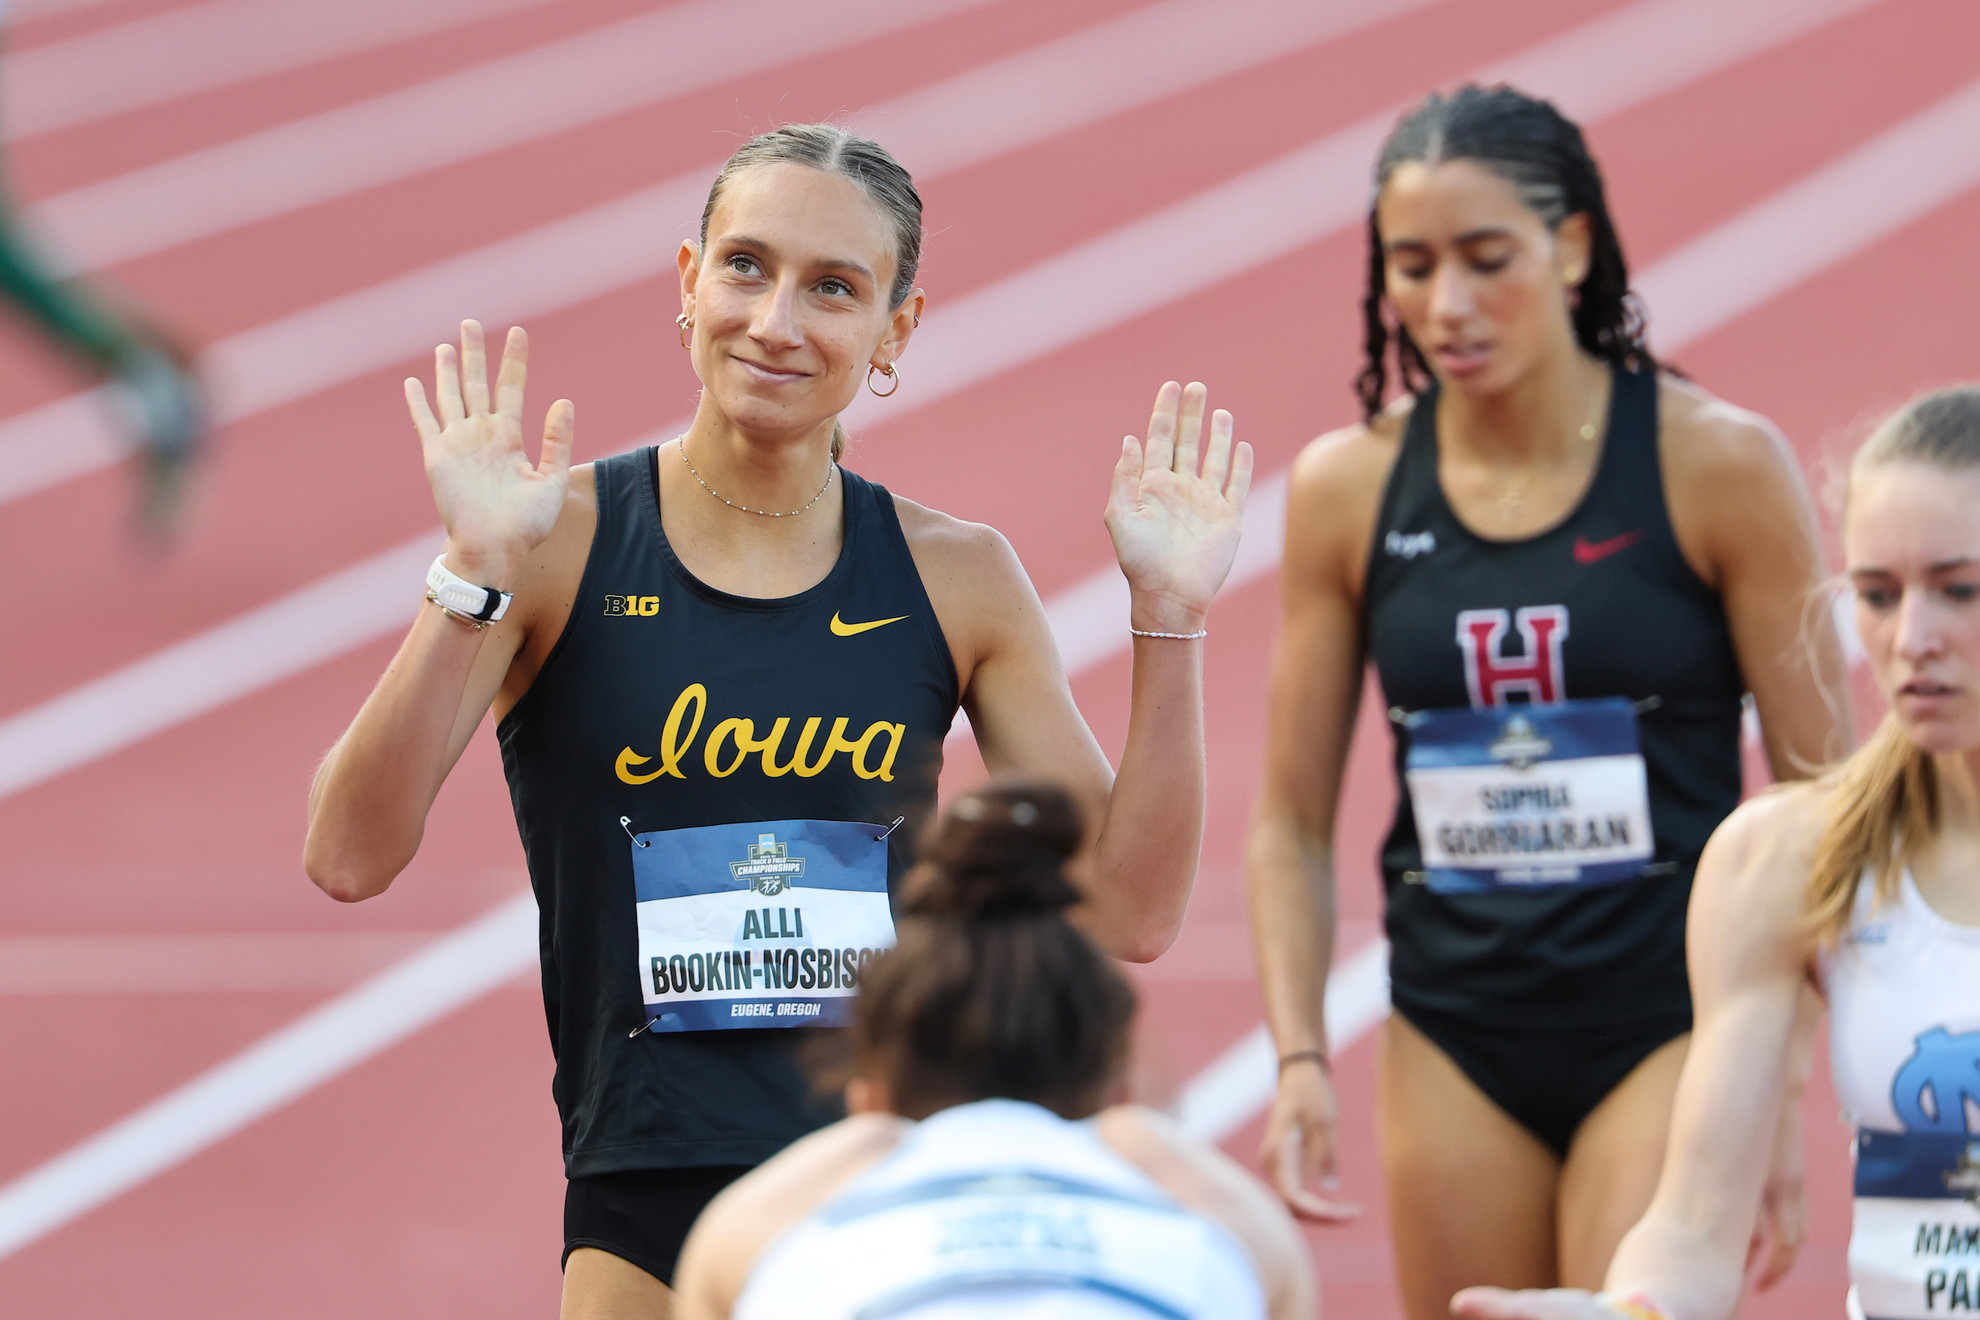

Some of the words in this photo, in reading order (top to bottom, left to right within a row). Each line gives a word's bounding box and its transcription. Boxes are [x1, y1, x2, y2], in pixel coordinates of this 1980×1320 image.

[1456, 604, 1569, 710] H
[614, 683, 906, 785] Iowa
[737, 862, 801, 875] CHAMPIONSHIPS
[742, 907, 804, 940] ALLI
[650, 947, 893, 995] BOOKIN-NOSBIS
[731, 1004, 774, 1017] EUGENE,
[777, 1003, 821, 1016] OREGON
[1925, 1267, 1980, 1311] PA
